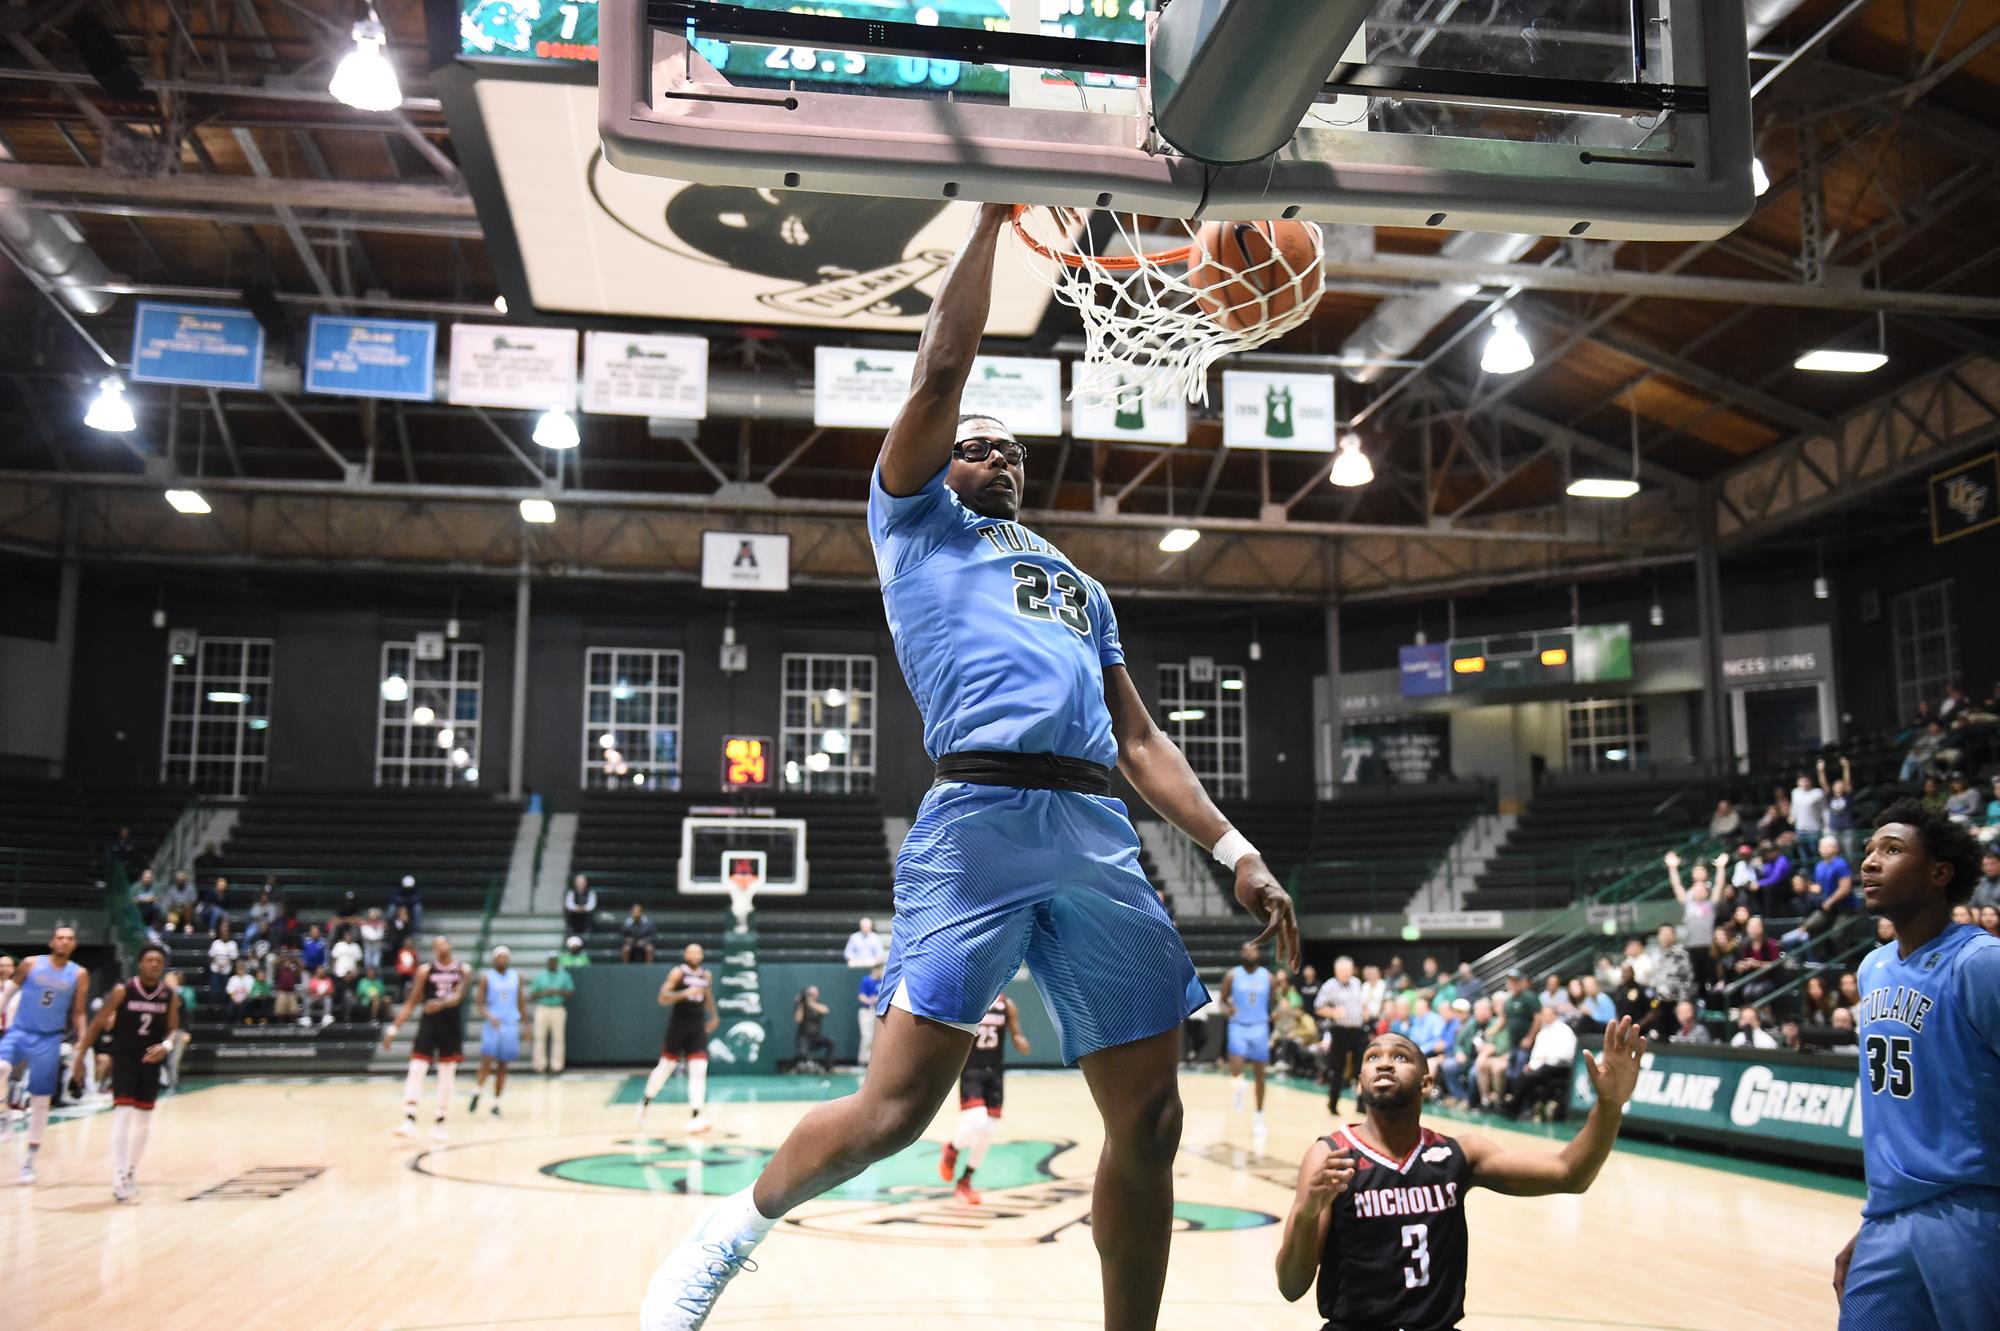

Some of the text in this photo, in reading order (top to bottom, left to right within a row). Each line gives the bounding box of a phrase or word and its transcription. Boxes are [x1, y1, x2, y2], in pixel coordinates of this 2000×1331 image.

[1011, 561, 1091, 636] 23
[137, 1013, 153, 1035] 2
[1863, 985, 1934, 1033] TULANE
[1730, 1065, 1854, 1127] GREEN
[1866, 1034, 1914, 1099] 35
[1354, 1182, 1458, 1218] NICHOLLS
[1401, 1223, 1431, 1289] 3
